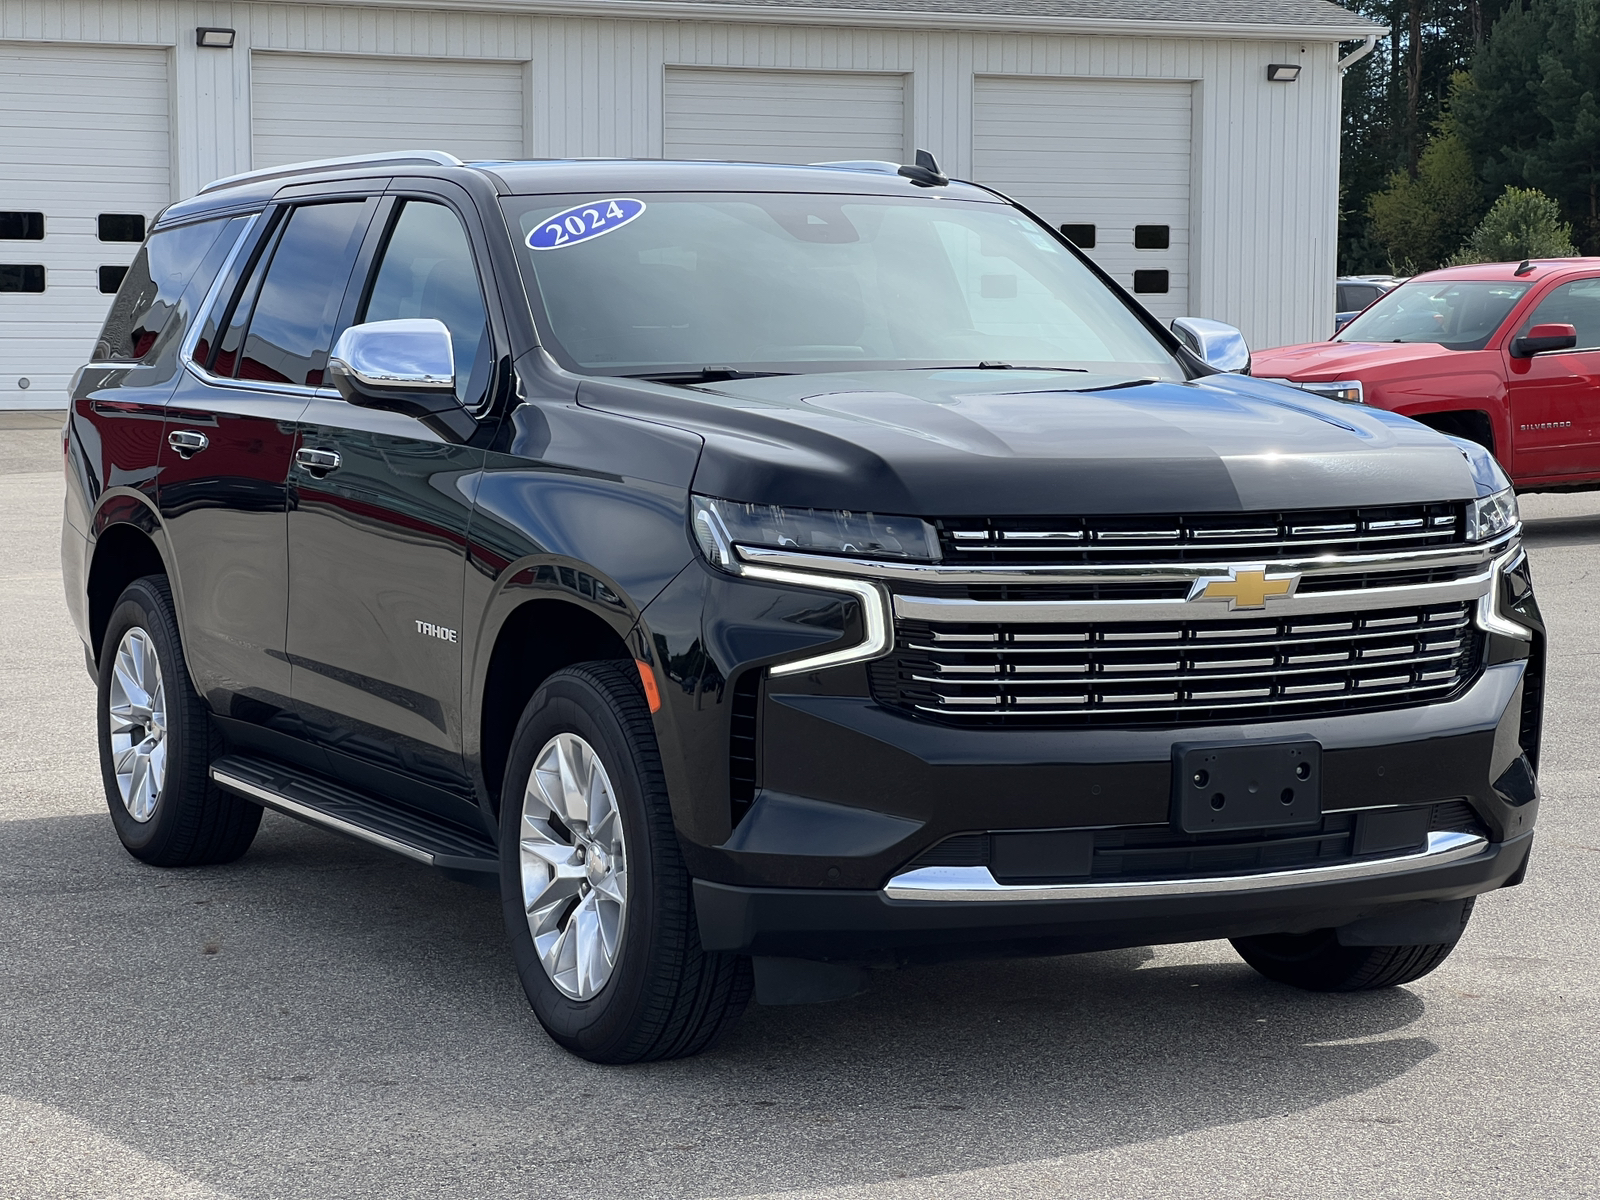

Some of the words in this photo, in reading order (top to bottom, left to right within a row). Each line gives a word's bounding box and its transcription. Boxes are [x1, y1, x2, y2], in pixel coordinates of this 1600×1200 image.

[546, 201, 624, 245] 2024
[1520, 421, 1571, 431] SILVERADO
[415, 620, 457, 643] TAHOE
